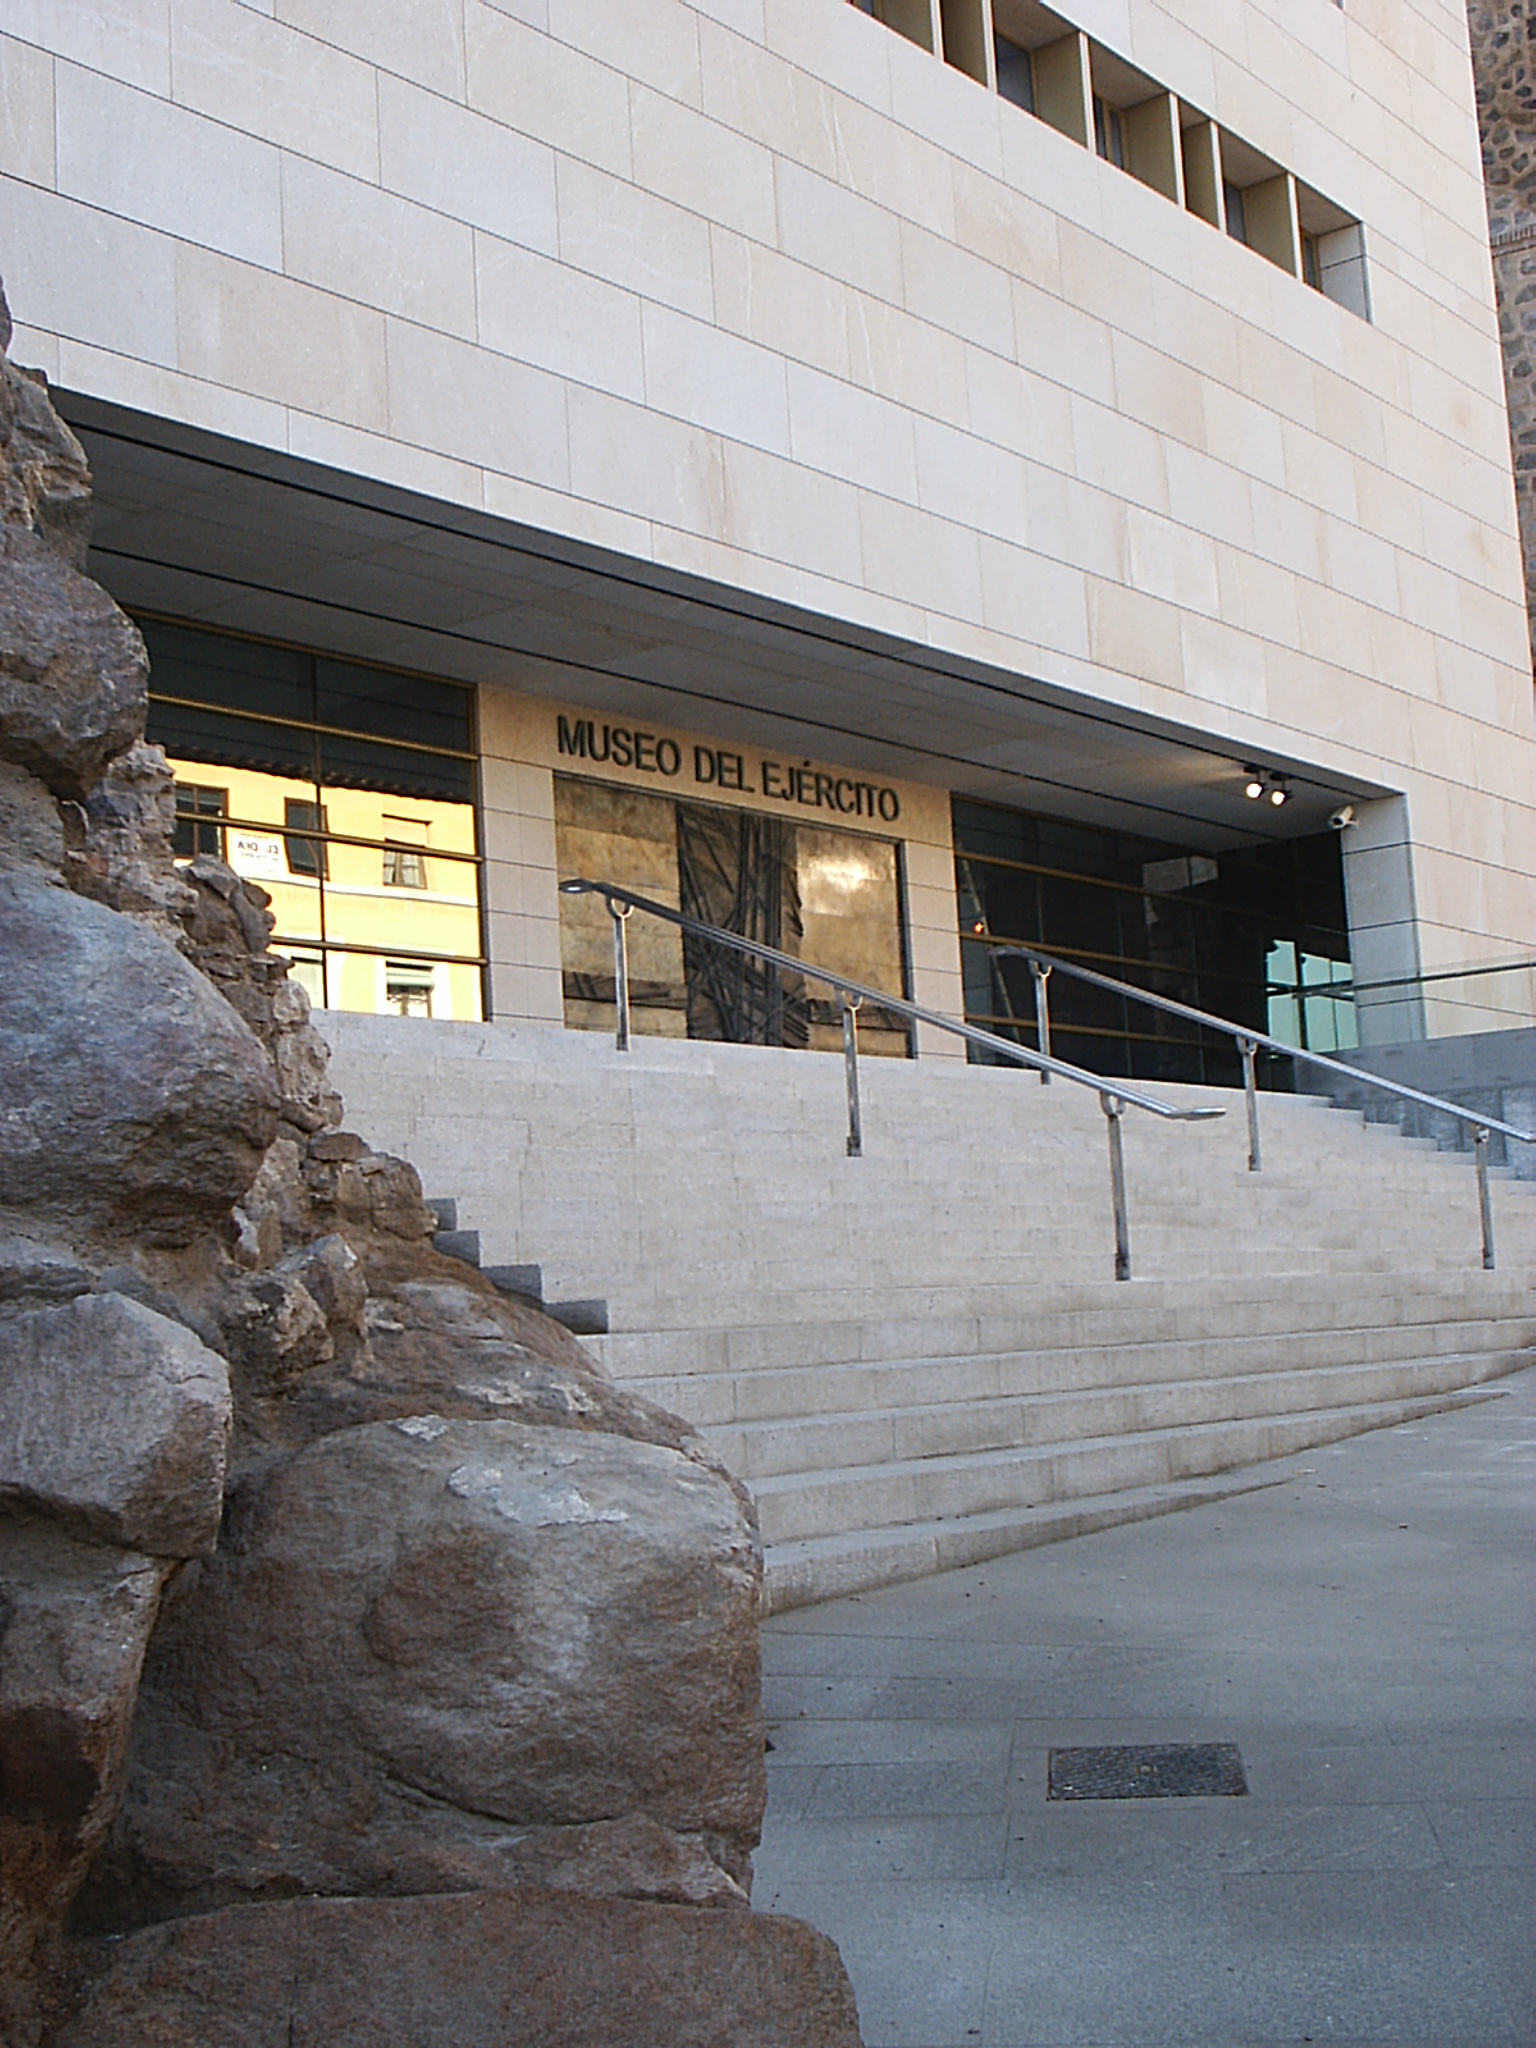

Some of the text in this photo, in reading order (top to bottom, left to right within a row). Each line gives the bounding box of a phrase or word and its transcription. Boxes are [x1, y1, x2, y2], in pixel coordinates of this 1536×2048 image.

[556, 715, 900, 822] MUSEO DEL EJÉRCITO
